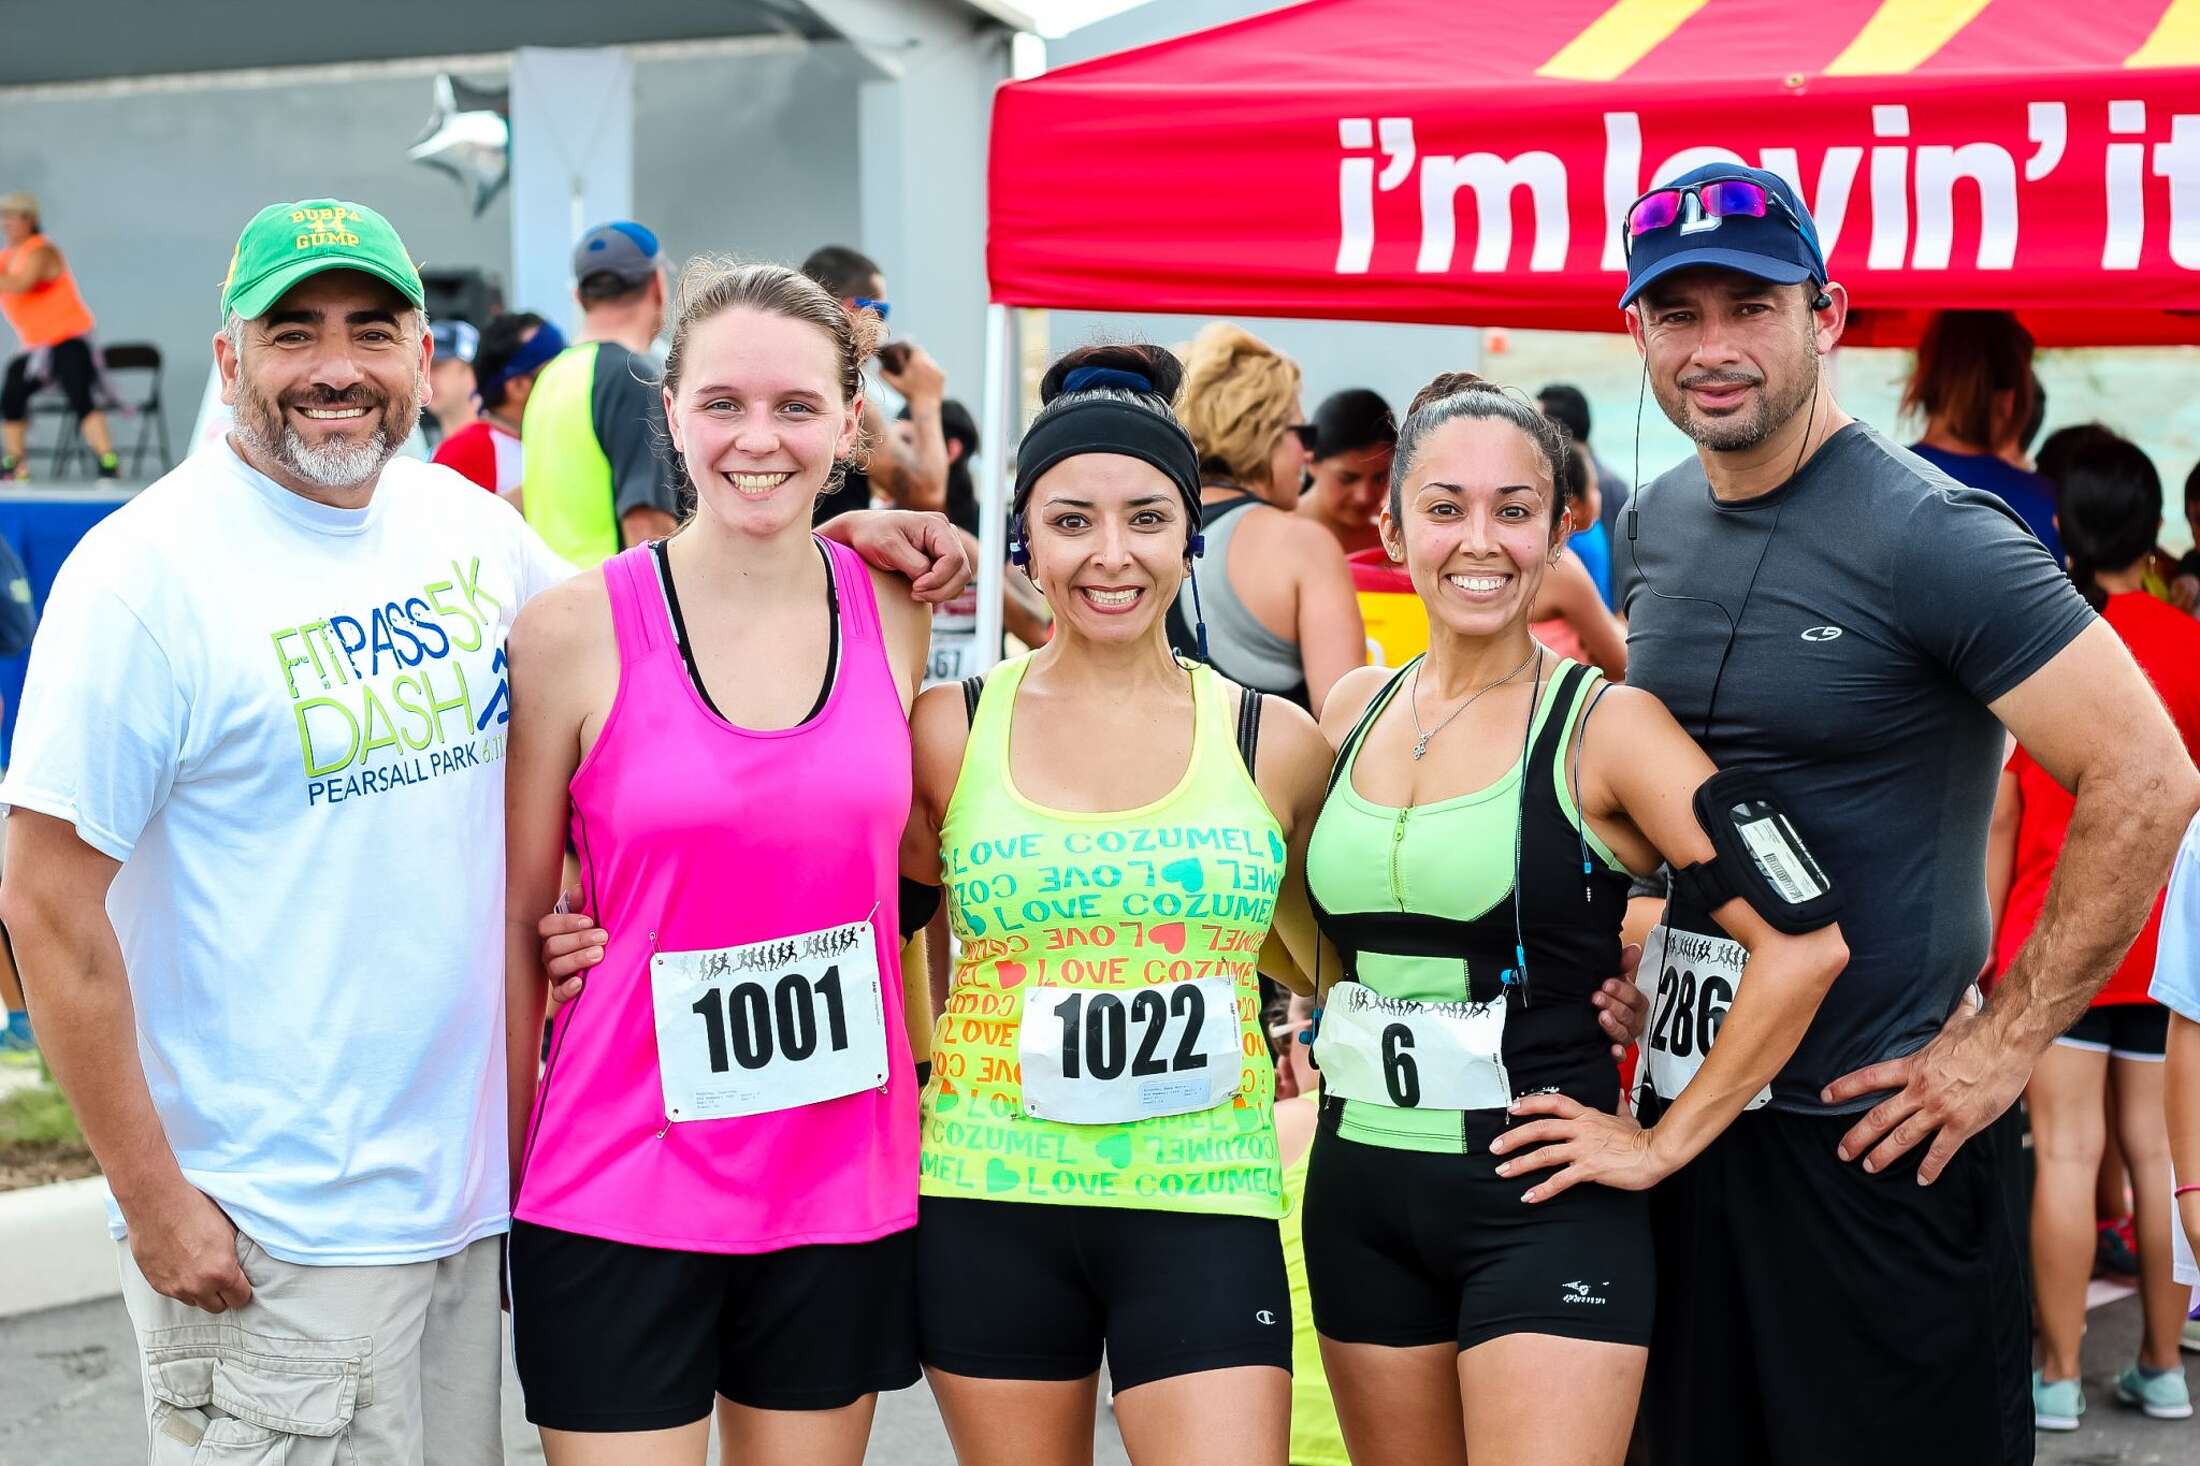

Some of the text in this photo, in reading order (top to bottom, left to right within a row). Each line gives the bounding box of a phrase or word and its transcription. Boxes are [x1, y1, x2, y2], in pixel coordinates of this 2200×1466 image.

[1601, 100, 2068, 272] lvin'
[2101, 99, 2200, 272] it
[291, 207, 363, 223] BUBBA
[296, 232, 360, 249] GUMP
[294, 660, 475, 778] DASH
[308, 758, 429, 806] PEARSALL
[430, 741, 480, 777] PARK
[953, 828, 1264, 875] LOVE COZUMEL
[1038, 859, 1155, 893] LOVE
[993, 894, 1102, 931] LOVE
[1122, 893, 1271, 925] COZUME
[1043, 922, 1143, 950] LOVE
[1037, 957, 1129, 987] LOVE
[692, 965, 848, 1073] 1001
[944, 1016, 1019, 1047] LOVE
[1054, 983, 1208, 1081] 1022
[1651, 965, 1733, 1057] 286
[1382, 1022, 1420, 1108] 6
[932, 1119, 1077, 1164] COZUMEL
[1028, 1166, 1120, 1196] LOVE
[1135, 1167, 1279, 1197] COZUMEL
